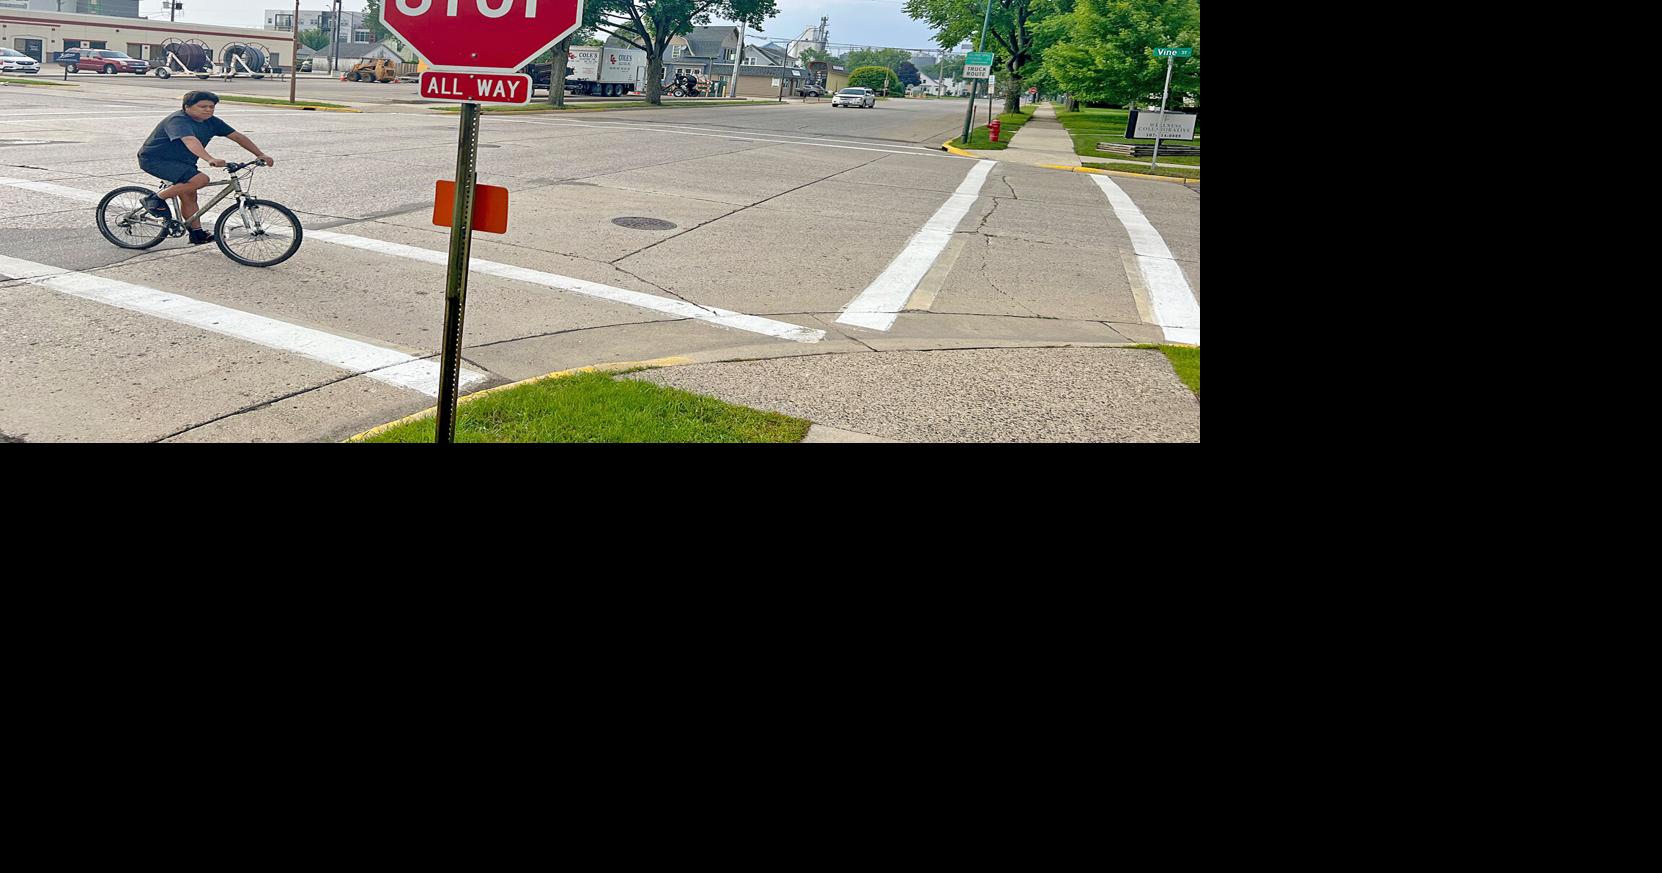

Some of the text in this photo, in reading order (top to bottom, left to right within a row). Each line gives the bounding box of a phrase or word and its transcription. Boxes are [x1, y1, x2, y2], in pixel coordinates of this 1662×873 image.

[1158, 48, 1178, 56] Vine
[427, 76, 520, 98] ALL WAY
